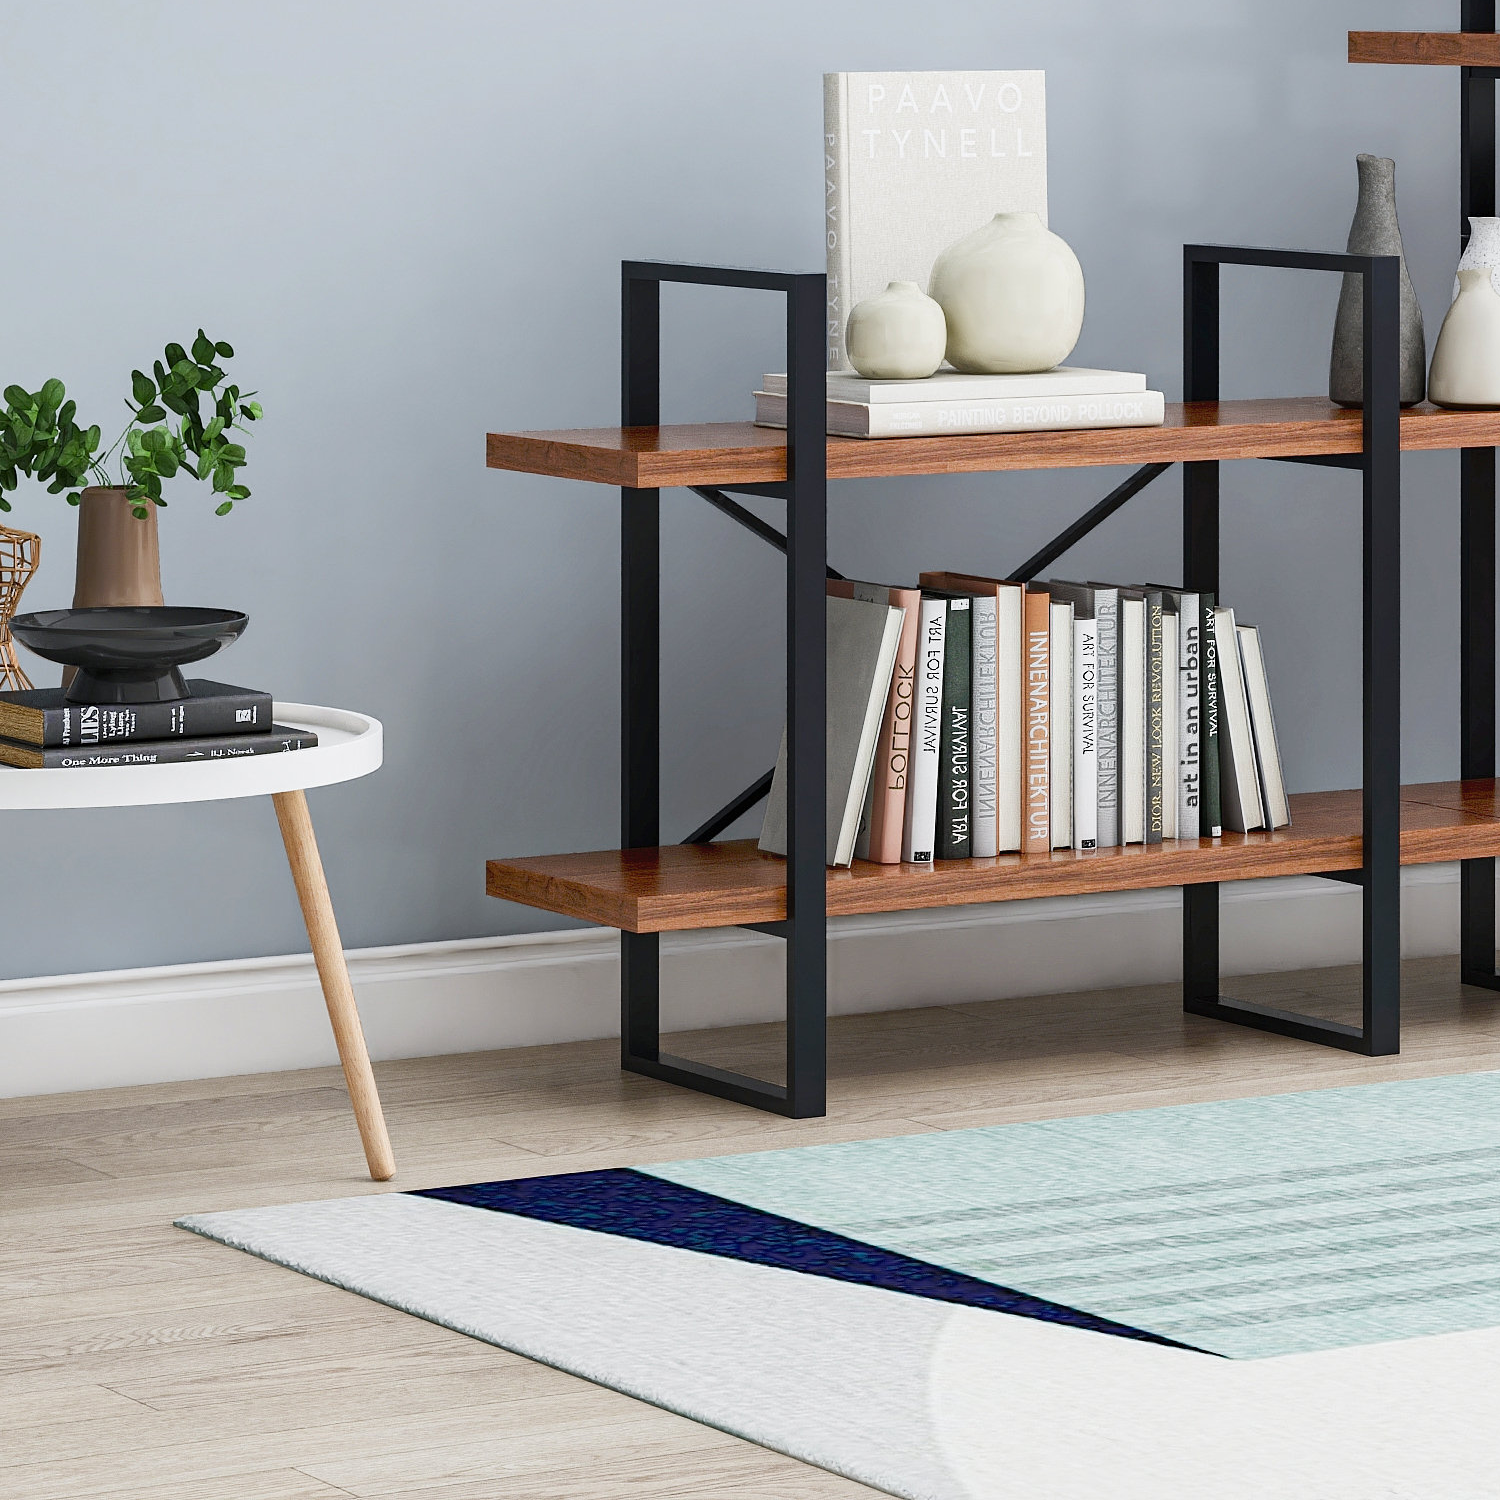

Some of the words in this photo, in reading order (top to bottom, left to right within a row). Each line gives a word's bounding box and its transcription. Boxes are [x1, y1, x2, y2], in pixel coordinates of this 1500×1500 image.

[867, 82, 1023, 113] PAAVO
[861, 127, 1033, 159] TYNELL
[825, 133, 837, 250] PAAVO
[937, 407, 1005, 427] PAINTING
[1013, 404, 1071, 425] BEYOND
[1077, 401, 1144, 421] POLLOCK
[1205, 606, 1216, 634] ART
[1082, 633, 1095, 658] ART
[1151, 605, 1163, 702] REVOLUTION
[1179, 626, 1198, 698] urban
[1206, 639, 1217, 668] FOR
[1082, 663, 1095, 692] FOR
[1098, 604, 1118, 810] INNENARCHITEKTUR
[1187, 705, 1198, 735] an
[1207, 671, 1218, 737] SURVIVAL
[80, 706, 99, 744] LIES
[1029, 630, 1049, 840] INNENARCHITEKTUR
[1082, 694, 1095, 756] SURVIVAL
[1151, 708, 1163, 750] LOOK
[62, 758, 87, 767] One
[89, 756, 119, 765] More
[121, 753, 158, 762] Thing
[1180, 742, 1198, 765] in
[1151, 753, 1163, 789] NEW
[1183, 773, 1198, 807] art
